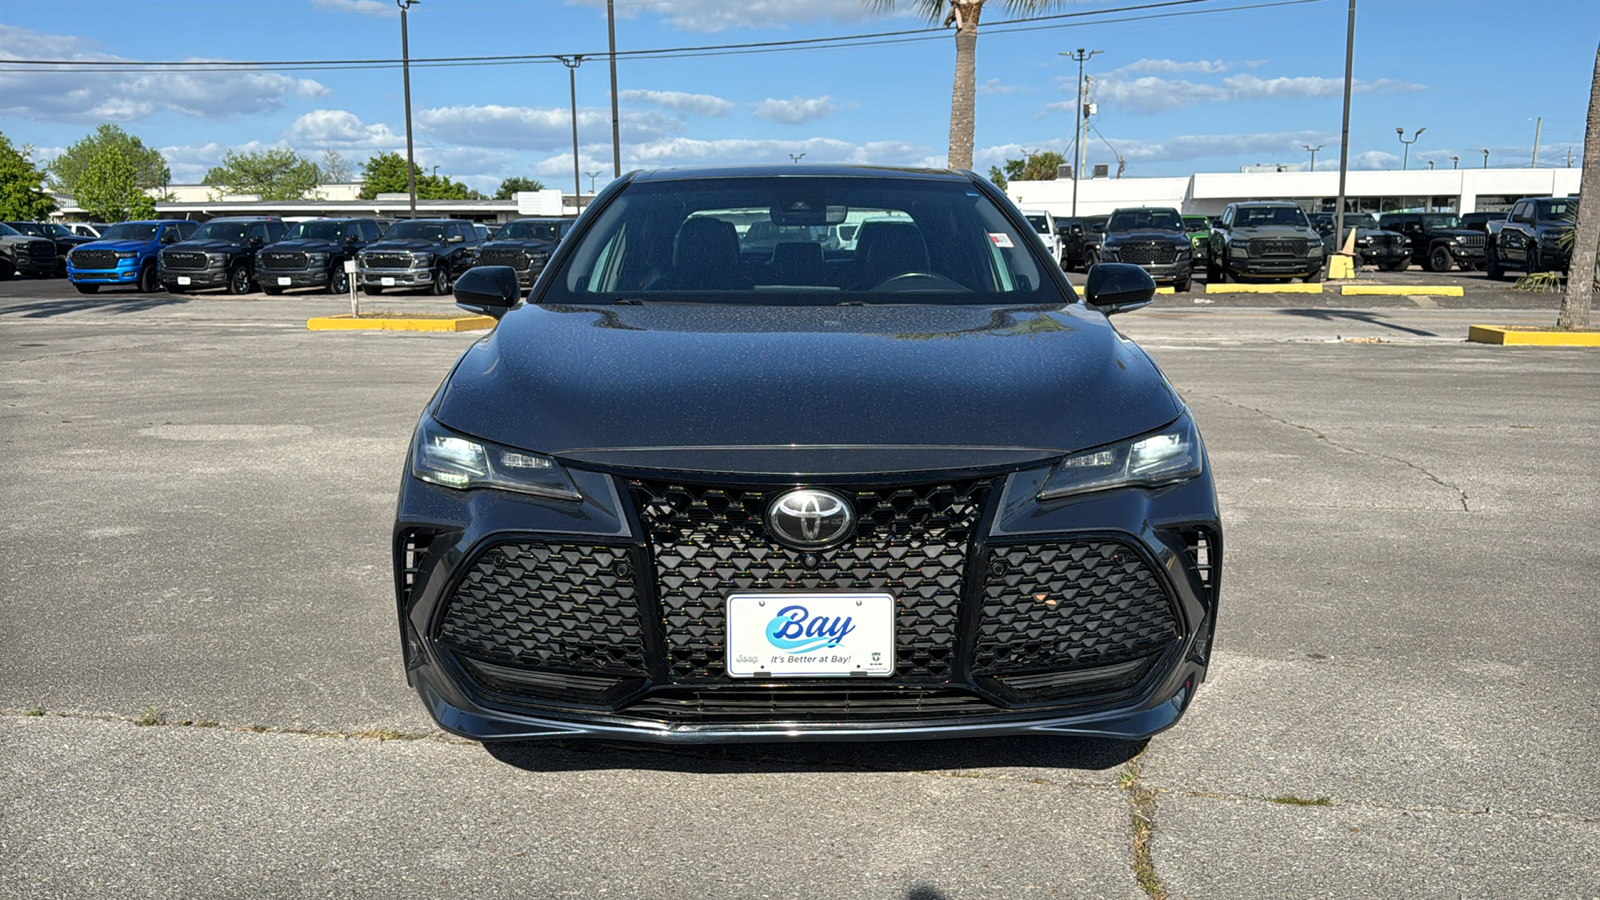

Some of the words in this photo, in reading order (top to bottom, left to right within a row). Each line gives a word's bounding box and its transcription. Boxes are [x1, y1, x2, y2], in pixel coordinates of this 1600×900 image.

[772, 605, 856, 648] Bay
[771, 655, 785, 663] It's
[787, 655, 817, 663] Better
[818, 655, 828, 663] at
[831, 655, 852, 665] Bay!
